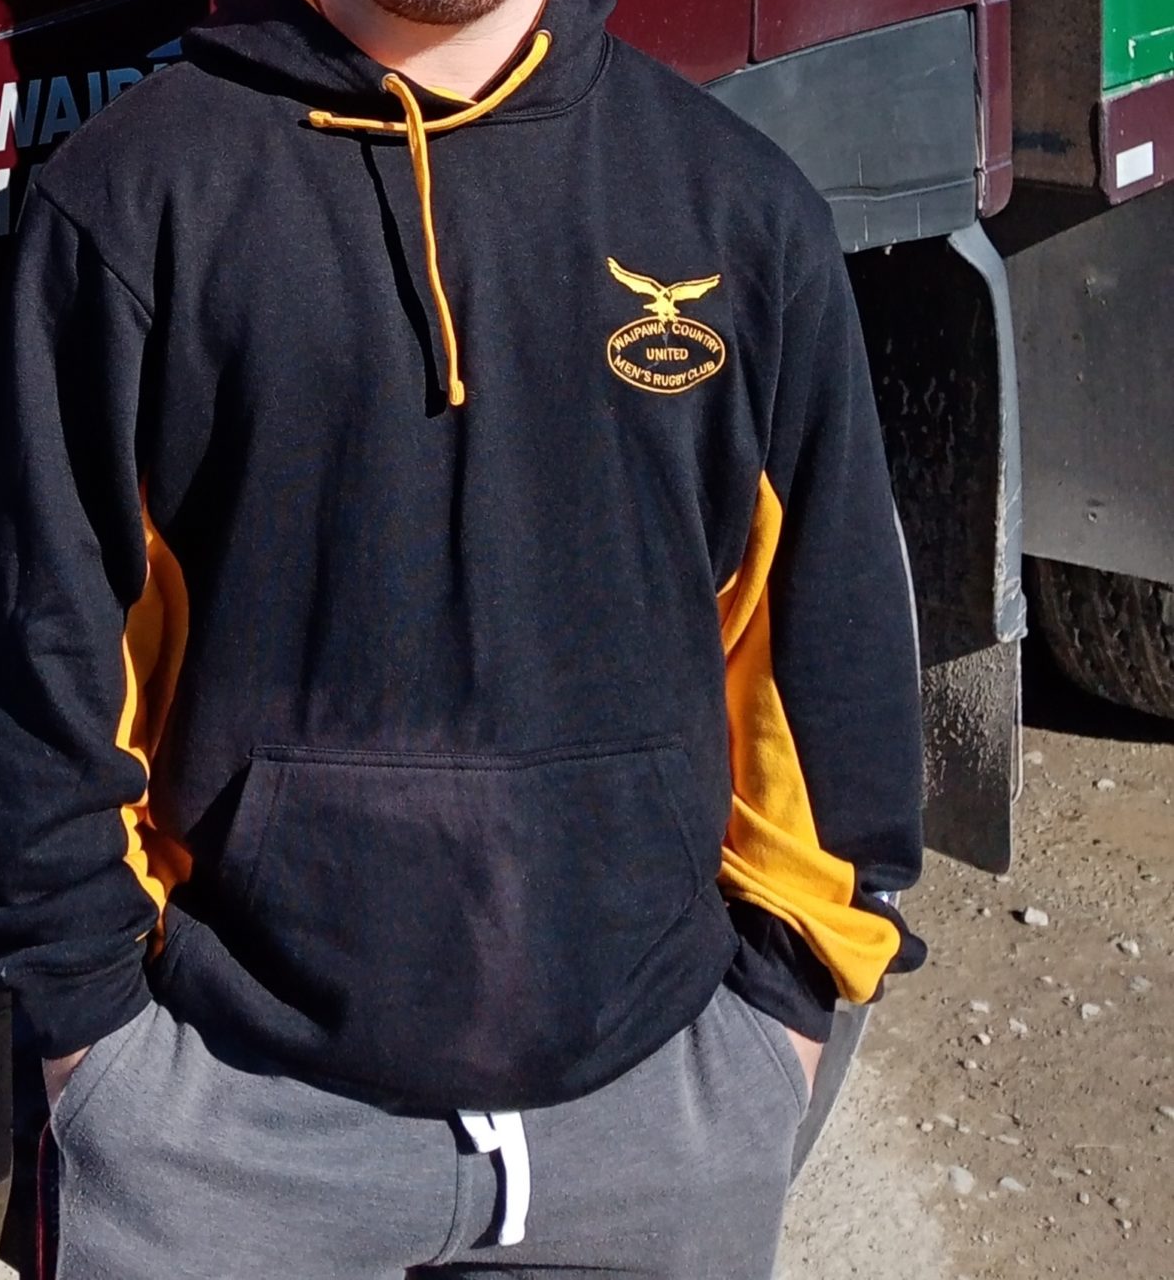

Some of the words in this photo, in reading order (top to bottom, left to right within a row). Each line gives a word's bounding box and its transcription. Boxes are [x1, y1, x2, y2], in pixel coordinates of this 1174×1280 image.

[612, 322, 666, 353] WAIPAWA
[671, 323, 721, 354] COUNTRY
[646, 348, 689, 360] UNITED
[613, 355, 652, 383] MEN'S
[653, 373, 688, 386] RUGBY
[687, 360, 716, 381] CLUB
